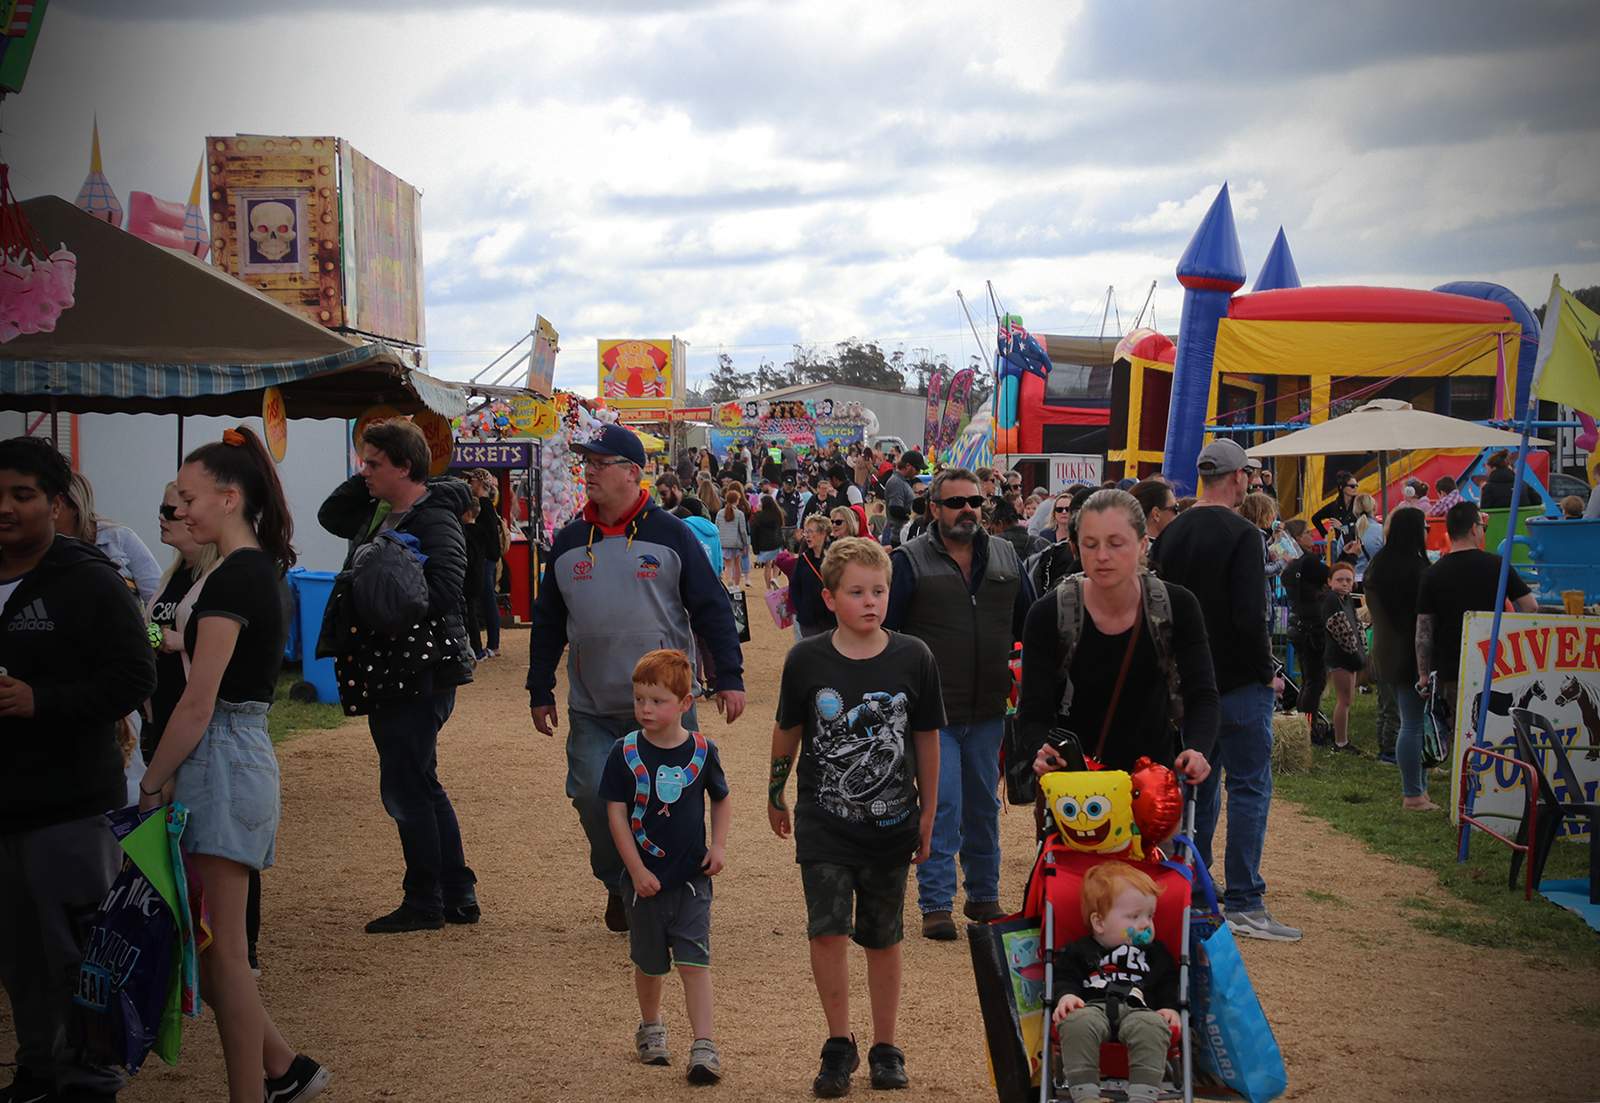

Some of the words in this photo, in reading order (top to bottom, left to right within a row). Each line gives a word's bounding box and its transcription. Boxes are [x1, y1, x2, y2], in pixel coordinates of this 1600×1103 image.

[719, 429, 753, 437] CATCH
[821, 428, 855, 436] CATCH
[453, 446, 521, 463] ICKETS
[1056, 462, 1096, 480] TICKETS
[8, 619, 55, 632] adidas
[1205, 1013, 1236, 1080] ABOARD
